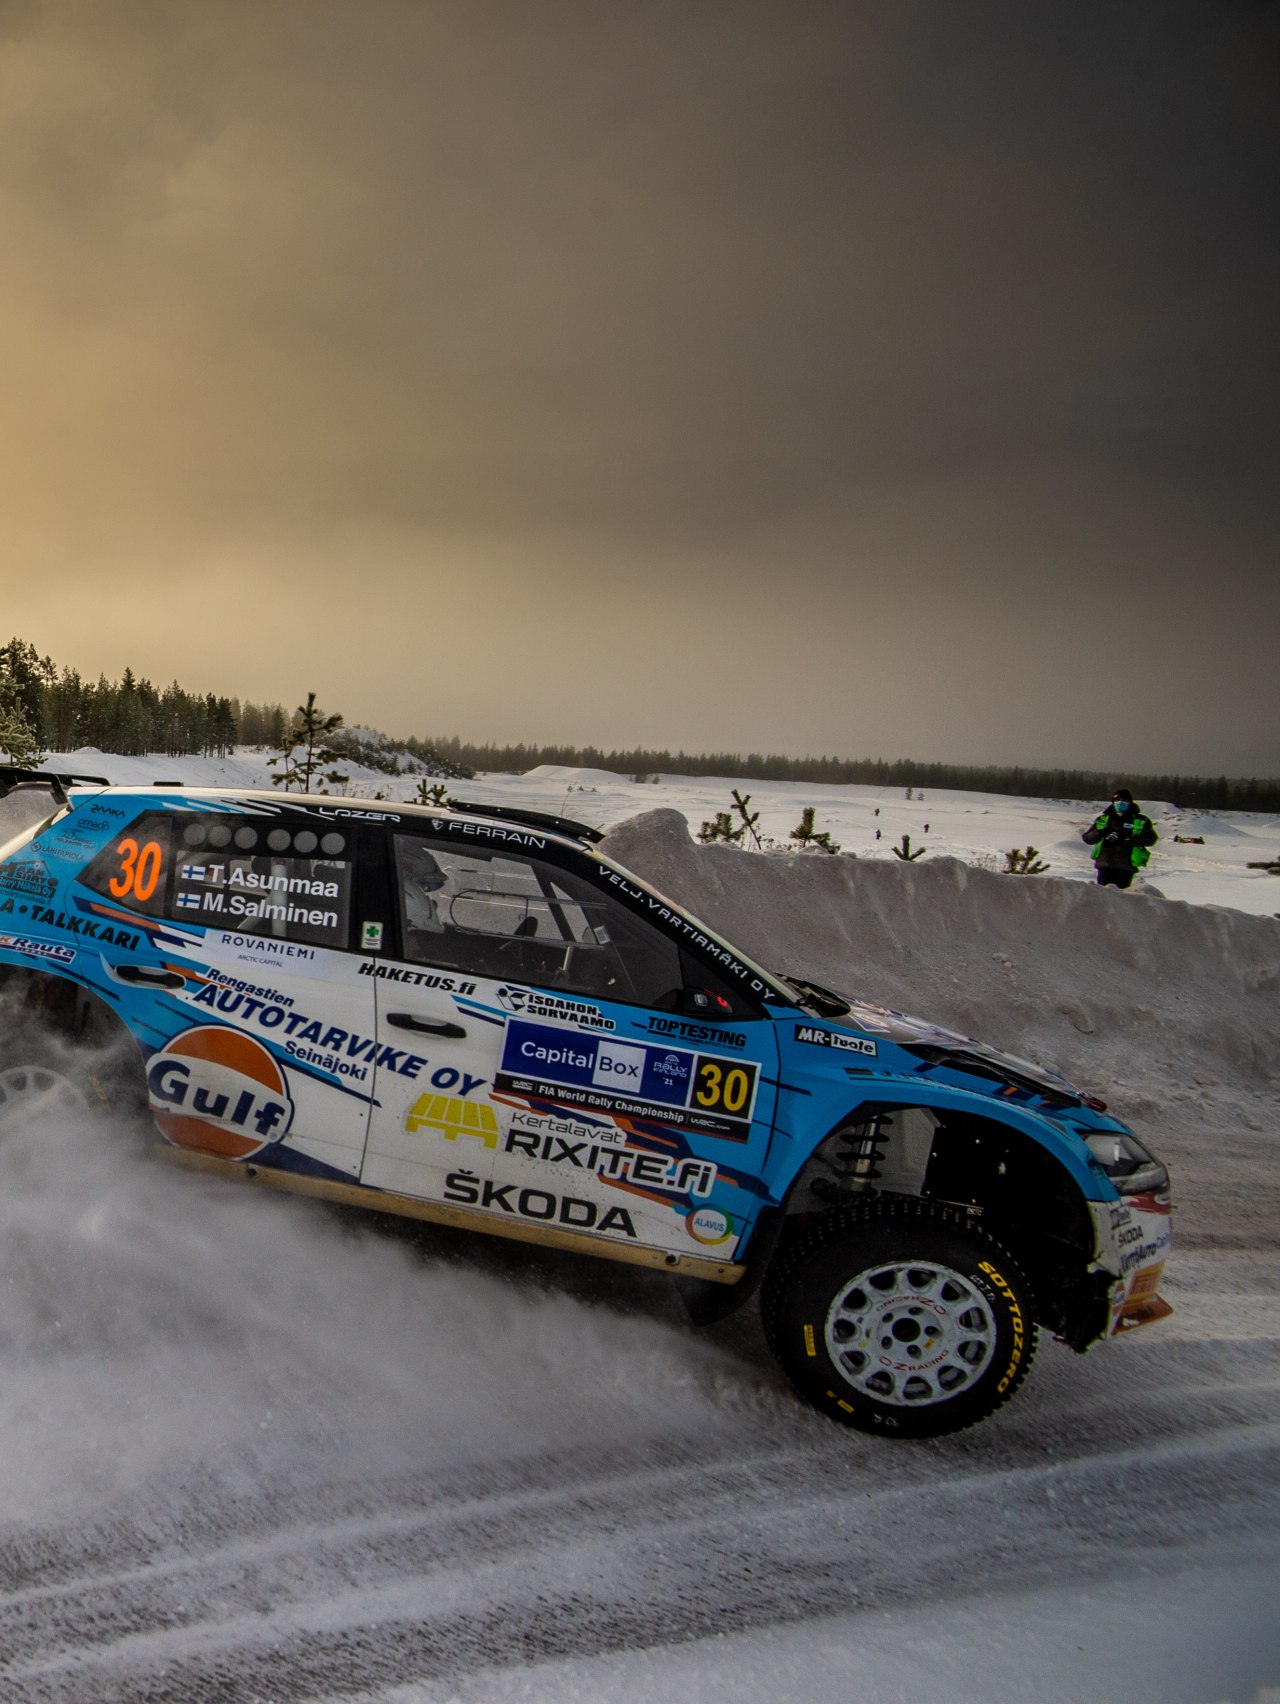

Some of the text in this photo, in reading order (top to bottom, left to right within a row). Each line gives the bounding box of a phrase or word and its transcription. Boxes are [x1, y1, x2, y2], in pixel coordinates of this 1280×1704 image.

[319, 806, 401, 823] LAZER
[448, 821, 546, 849] FERRAIN
[109, 838, 162, 901] 30
[209, 864, 339, 898] T.Asunmaa
[203, 892, 338, 928] M.Salminen
[30, 905, 141, 951] TALKKARI
[12, 938, 76, 958] Rauta
[221, 934, 315, 960] ROVANIEMI
[237, 954, 283, 968] ARCTIC CAPITAL
[206, 968, 295, 1007] Rengastien
[358, 962, 477, 995] HAKETUS.fi
[750, 978, 776, 1000] OY
[527, 1005, 615, 1030] SORVAAMO
[528, 994, 598, 1016] ISOAHON
[192, 983, 487, 1097] AUTOTARVIKE OY
[647, 1016, 747, 1048] TOPTESTING
[284, 1040, 368, 1082] Seinäjoki
[521, 1041, 640, 1078] Capital Box
[147, 1059, 286, 1135] Gulf
[538, 1085, 555, 1098] FIA
[557, 1088, 586, 1102] World
[587, 1094, 613, 1109] Rally
[615, 1100, 684, 1124] Championship
[696, 1064, 749, 1112] 30
[512, 1112, 623, 1144] Kertalavat
[505, 1129, 712, 1194] RIXITE.fi
[443, 1168, 638, 1238] ŠKODA
[695, 1217, 725, 1232] ALAVUS
[977, 1260, 1024, 1394] SOTTOZERO
